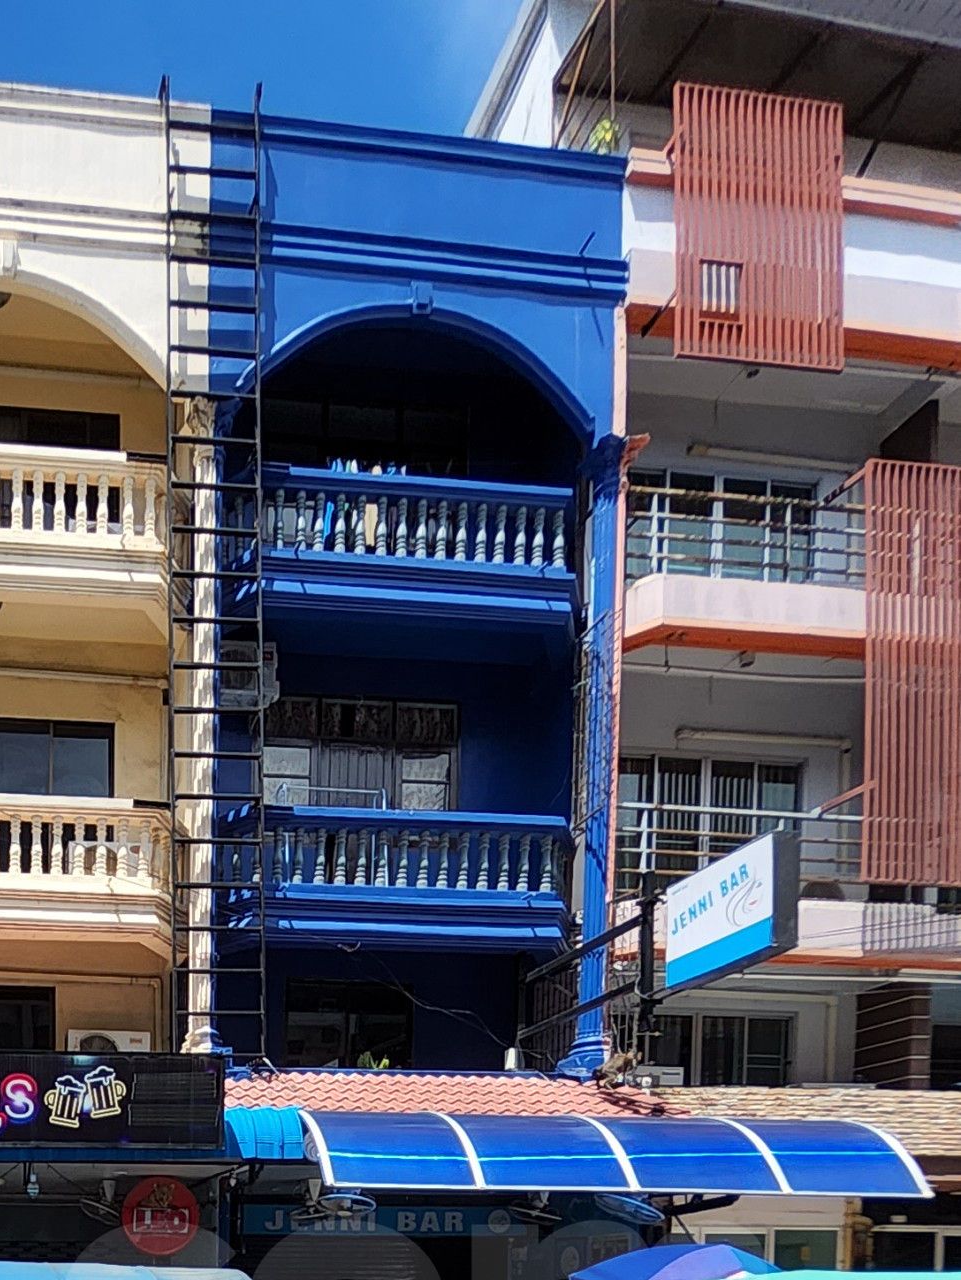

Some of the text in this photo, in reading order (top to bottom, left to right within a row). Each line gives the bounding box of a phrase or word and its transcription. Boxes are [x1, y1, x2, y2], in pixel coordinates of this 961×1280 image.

[671, 864, 749, 935] JENNI BAR
[397, 1210, 464, 1233] BAR
